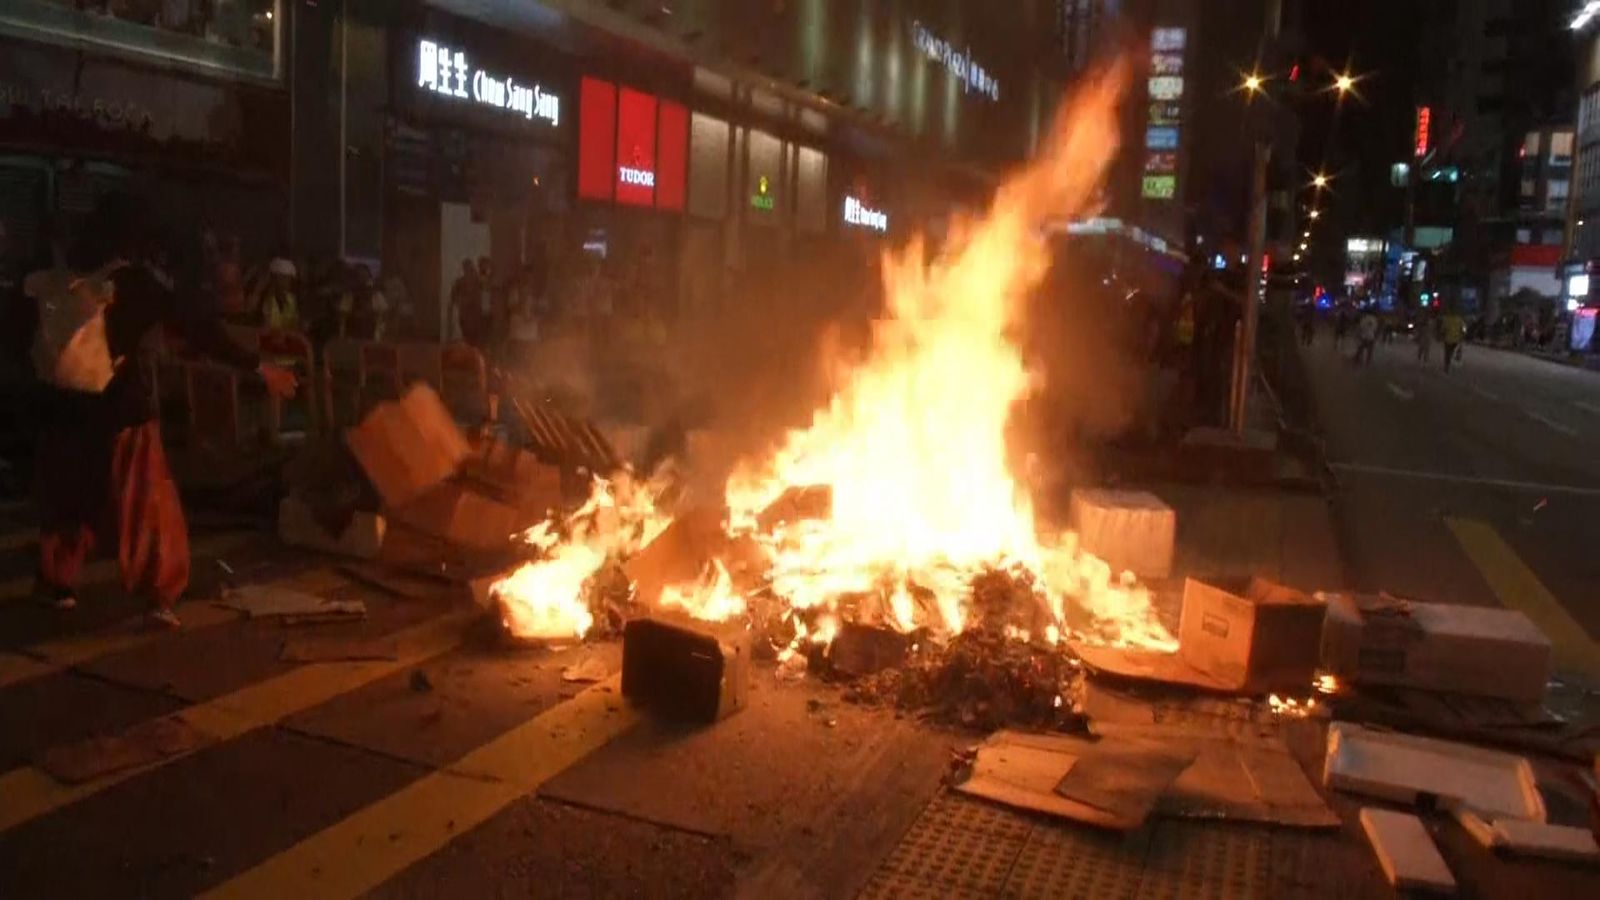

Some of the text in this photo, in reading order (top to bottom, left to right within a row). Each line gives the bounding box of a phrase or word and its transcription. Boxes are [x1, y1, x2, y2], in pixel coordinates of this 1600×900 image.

[418, 39, 468, 98] 周生生
[506, 77, 533, 120] Sang
[534, 84, 559, 126] Sang
[619, 166, 654, 187] TUDOR
